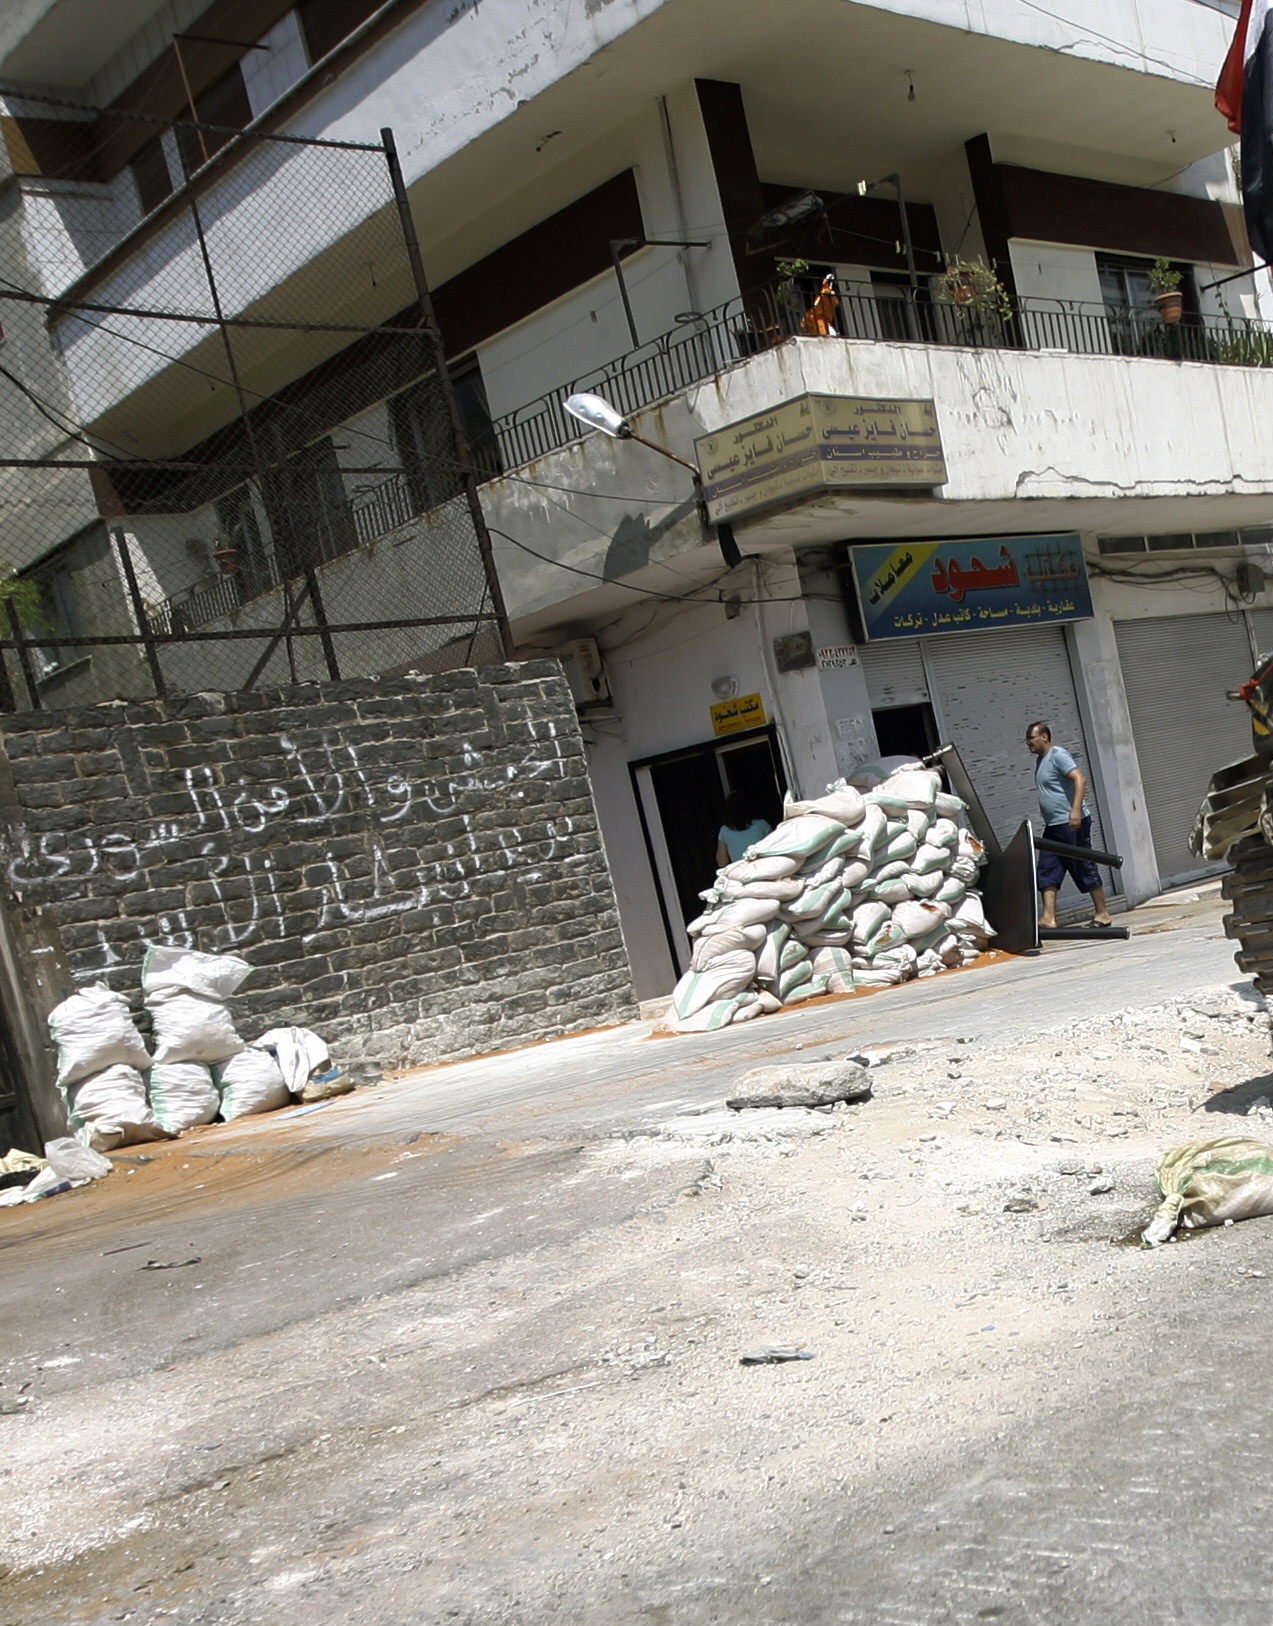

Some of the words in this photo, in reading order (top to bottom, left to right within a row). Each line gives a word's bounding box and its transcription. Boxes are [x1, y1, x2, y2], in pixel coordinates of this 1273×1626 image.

[855, 402, 901, 415] الدكتور
[733, 416, 778, 444] الدكتور
[822, 424, 860, 440] عيسى
[862, 418, 897, 441] فايز
[741, 434, 773, 467] فايز
[707, 454, 740, 480] عيسى
[978, 606, 1009, 619] مساحة
[1014, 603, 1041, 618] بلدية
[1047, 600, 1075, 615] عقارية
[894, 612, 923, 628] تركات
[932, 612, 952, 626] عدل
[953, 608, 972, 624] كاتب
[740, 699, 759, 718] مكتب
